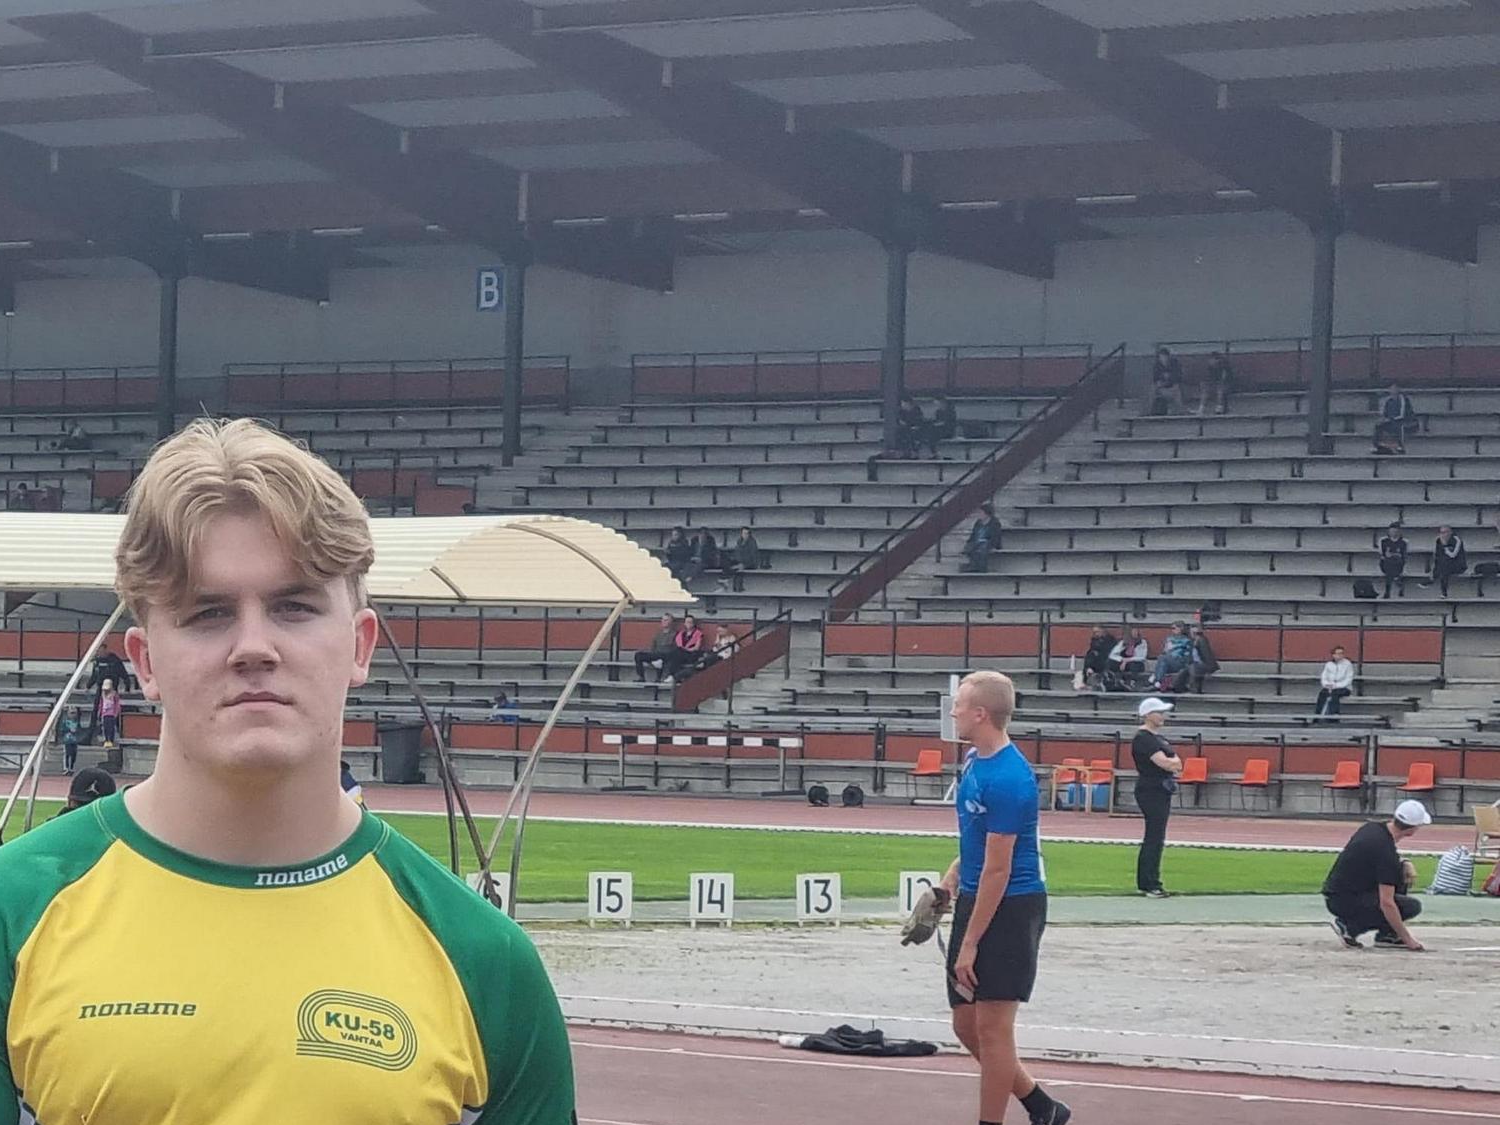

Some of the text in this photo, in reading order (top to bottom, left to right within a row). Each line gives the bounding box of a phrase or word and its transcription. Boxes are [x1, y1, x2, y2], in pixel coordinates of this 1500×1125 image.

[480, 271, 499, 308] B
[254, 854, 349, 886] noname
[596, 878, 623, 913] 15
[698, 879, 725, 913] 14
[804, 879, 833, 914] 13
[78, 1001, 197, 1020] noname
[325, 1011, 396, 1041] KU-58
[340, 1031, 384, 1049] VANTAA
